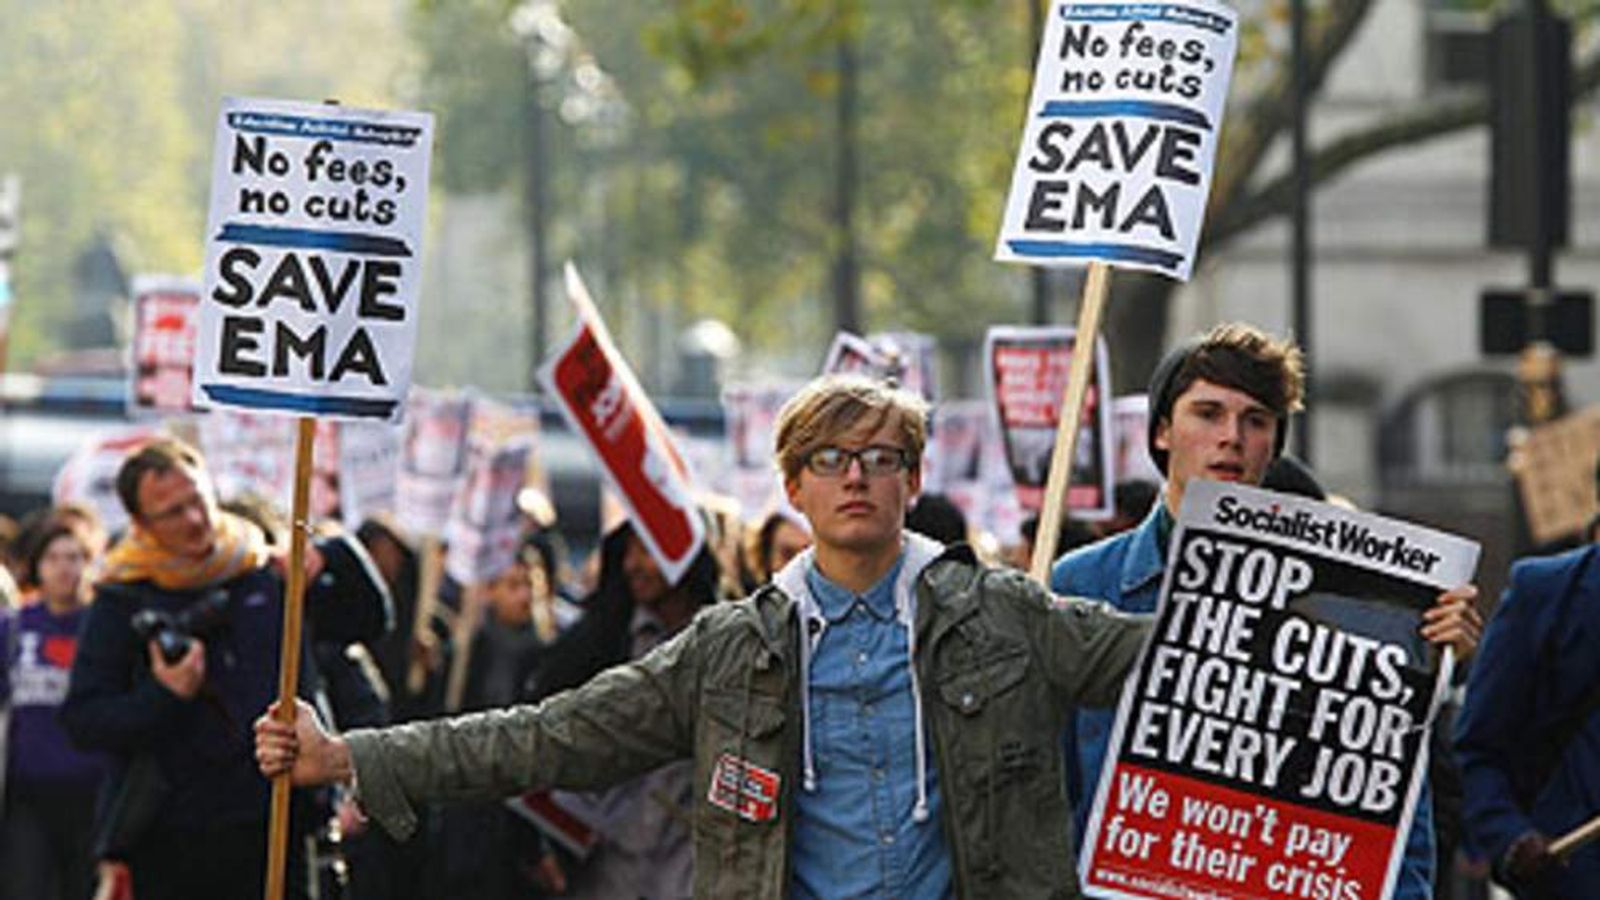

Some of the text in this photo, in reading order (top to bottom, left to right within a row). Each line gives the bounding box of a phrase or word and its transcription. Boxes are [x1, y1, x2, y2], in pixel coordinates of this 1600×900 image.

[1059, 21, 1214, 73] No fees,
[1061, 65, 1202, 99] no cuts
[233, 134, 406, 193] No fees,
[1028, 120, 1201, 186] SAVE
[239, 189, 397, 226] no cuts
[1024, 180, 1176, 241] EMA
[212, 248, 405, 321] SAVE
[218, 316, 387, 386] EMA
[1178, 536, 1314, 610] STOP
[1164, 592, 1414, 705] THE CUTS,
[1145, 644, 1413, 760] FIGHT FOR
[1131, 700, 1401, 813] EVERY JOB
[1117, 771, 1352, 867] We won't pay
[1104, 815, 1362, 900] for their crisis
